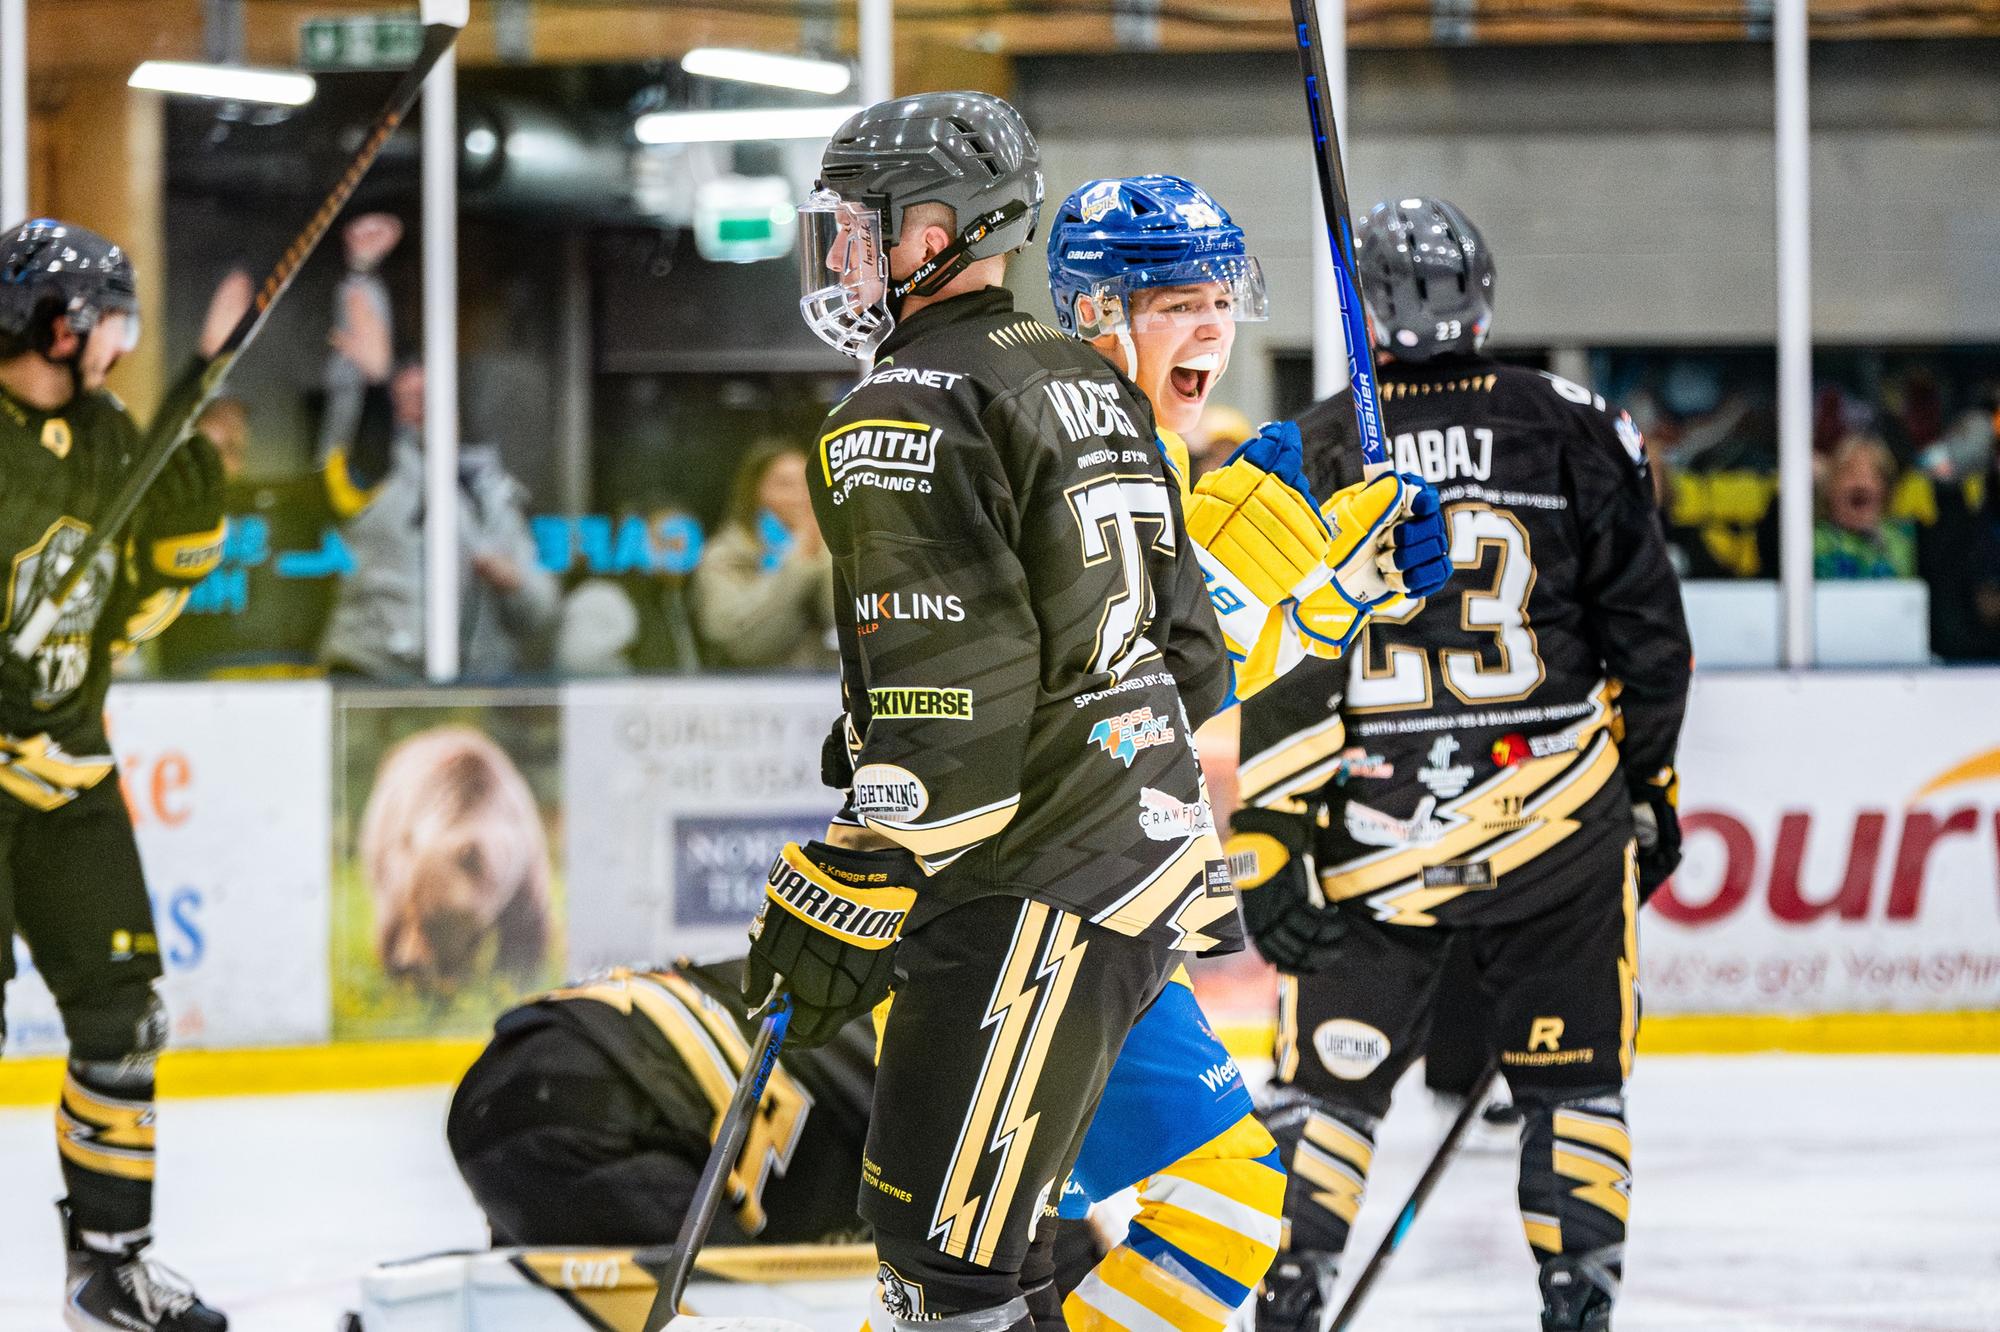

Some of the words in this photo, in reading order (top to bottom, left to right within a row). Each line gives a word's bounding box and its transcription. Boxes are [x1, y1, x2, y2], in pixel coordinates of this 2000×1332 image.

[1435, 319, 1462, 342] 23
[1358, 372, 1379, 442] BAUER
[829, 430, 927, 470] SMITH
[1384, 425, 1494, 483] ABAJ
[843, 472, 916, 499] CYCLING
[1073, 677, 1144, 709] SPONSORED
[1110, 706, 1153, 731] BOSS
[1119, 715, 1169, 740] PLANT
[1133, 727, 1175, 750] SALES
[853, 781, 919, 809] IGHTNING
[1141, 804, 1208, 827] CRAWFO
[867, 872, 889, 883] #25
[1528, 1014, 1566, 1053] R
[878, 1181, 913, 1203] KEYNES
